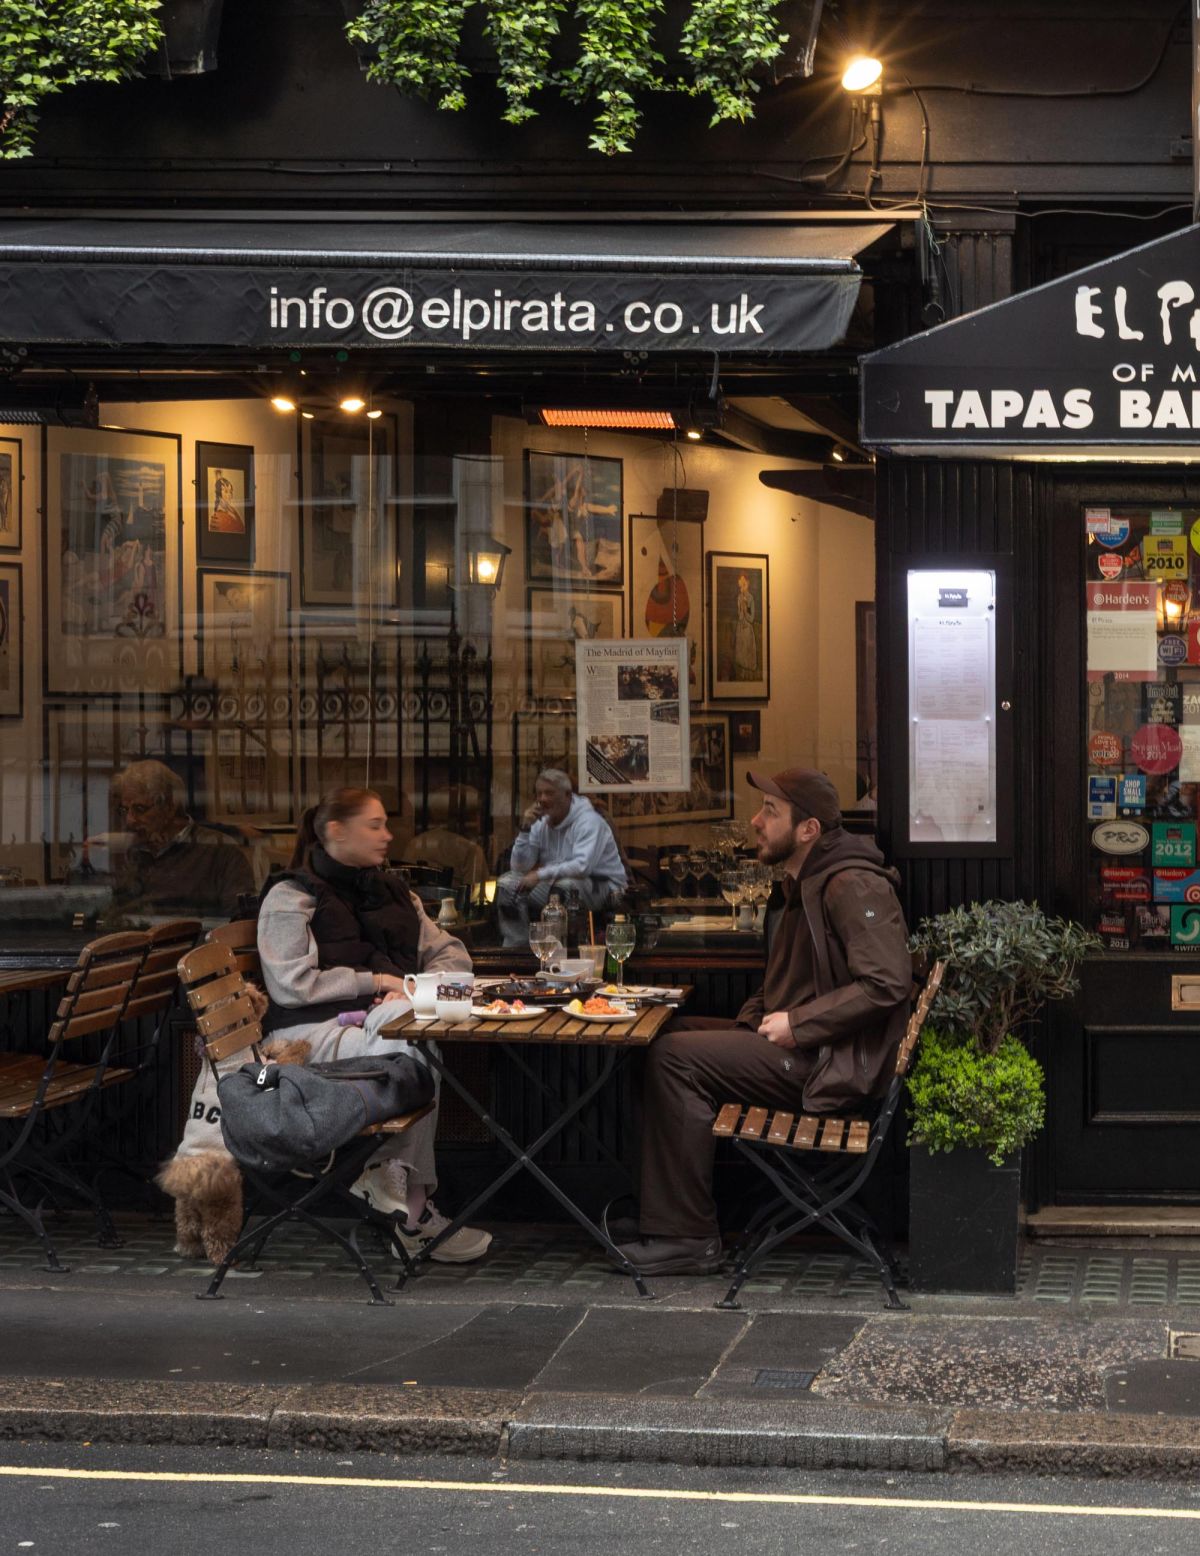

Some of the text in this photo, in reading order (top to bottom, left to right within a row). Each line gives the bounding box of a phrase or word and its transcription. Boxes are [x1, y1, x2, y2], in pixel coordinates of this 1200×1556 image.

[269, 286, 766, 341] info@elpirata.co.uk
[1112, 363, 1154, 383] OF
[925, 388, 1094, 429] TAPAS
[1147, 556, 1185, 570] 2010
[1105, 593, 1150, 605] Harden's
[586, 647, 678, 658] The Madrid of Mayfair
[1114, 672, 1129, 680] 2014
[1125, 779, 1141, 787] SHOP
[1123, 787, 1141, 796] SMALL
[1102, 831, 1140, 844] PRS
[1155, 843, 1192, 856] 2012
